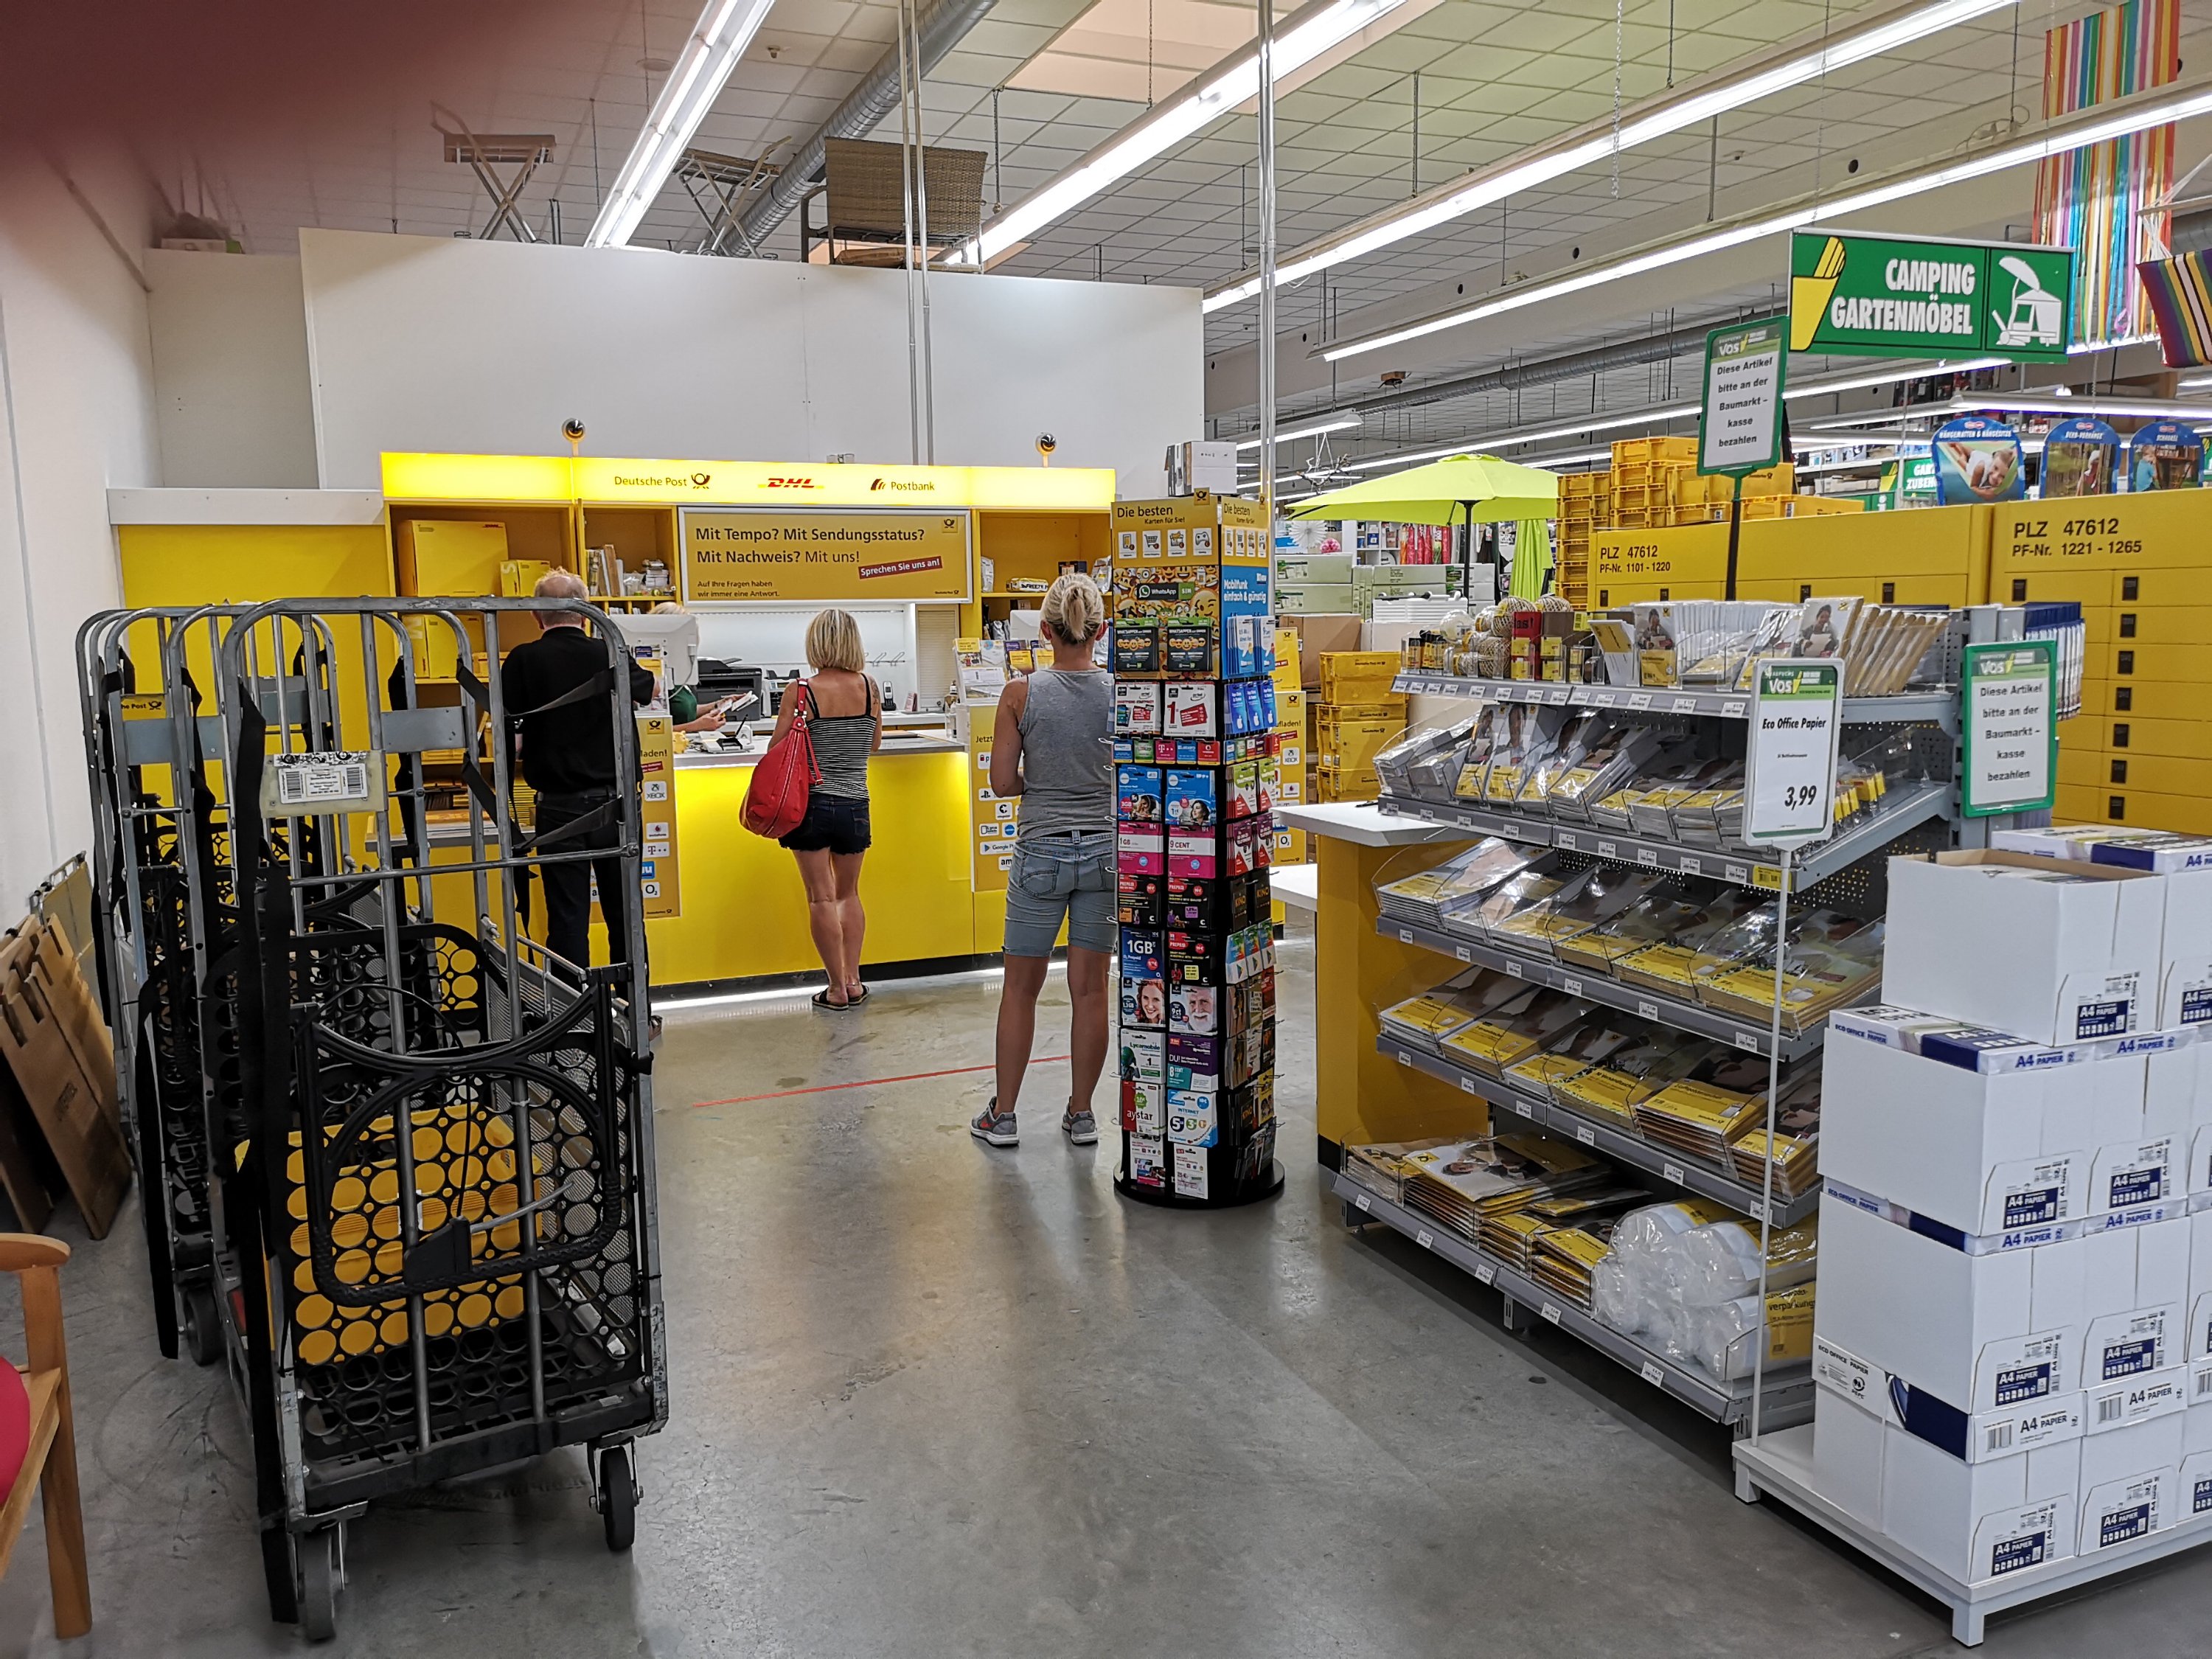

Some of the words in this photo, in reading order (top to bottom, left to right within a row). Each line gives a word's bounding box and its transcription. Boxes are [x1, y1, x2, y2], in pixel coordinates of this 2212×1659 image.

[1885, 258, 1975, 295] CAMPING
[1831, 293, 1973, 335] GARTENMÖBEL
[1719, 343, 1739, 356] VOS
[1717, 364, 1740, 375] Diese
[1742, 357, 1773, 370] Artikel
[1718, 383, 1738, 394] bitte
[1753, 377, 1768, 387] der
[1719, 397, 1761, 411] Baumarkt
[1728, 417, 1753, 428] kasse
[1719, 435, 1757, 447] bezahlen
[615, 476, 662, 486] Deutsche
[666, 477, 687, 487] Post
[768, 479, 815, 487] DHL
[891, 481, 935, 491] Postbank
[1117, 507, 1134, 518] Die
[1138, 506, 1173, 516] besten
[1224, 503, 1233, 514] Die
[1234, 504, 1251, 515] besten
[2014, 521, 2048, 538] PLZ
[2063, 518, 2119, 536] 47612
[696, 527, 720, 540] Mit
[724, 528, 779, 543] Tempo?
[784, 529, 807, 540] Mit
[812, 529, 925, 543] Sendungsstatus?
[1601, 547, 1619, 559] PLZ
[1627, 545, 1658, 558] 47612
[2012, 544, 2052, 557] PF-Nr.
[2061, 542, 2092, 555] 1221
[2108, 540, 2142, 553] 1265
[697, 551, 722, 563] Mit
[726, 550, 800, 563] Nachweis?
[805, 551, 828, 563] Mit
[832, 551, 860, 563] uns!
[860, 565, 897, 577] Sprechen
[898, 563, 910, 571] Sie
[912, 560, 925, 569] uns
[927, 558, 940, 567] an!
[1600, 563, 1621, 573] PF-Nr.
[1627, 563, 1644, 572] 1101
[1652, 562, 1671, 571] 1220
[1224, 579, 1248, 590] Mobilfunk
[1224, 591, 1242, 602] einfach
[1248, 591, 1266, 604] günstig
[1980, 661, 2005, 675] VOS
[1770, 679, 1793, 694] VOS
[1980, 687, 2008, 697] Diese
[2011, 684, 2042, 695] Artikel
[1167, 701, 1175, 724] 1
[1983, 709, 2006, 718] bitte
[2023, 706, 2039, 715] der
[1276, 720, 1301, 728] ufladen!
[1762, 718, 1774, 729] Eco
[1777, 717, 1799, 728] Office
[1801, 717, 1826, 731] Papier
[1986, 727, 2033, 739] Baumarkt
[640, 748, 667, 758] laden!
[1997, 750, 2025, 759] kasse
[1988, 770, 2031, 781] bezahlen
[1784, 785, 1817, 810] 3,99
[2185, 855, 2202, 868] A4
[1256, 887, 1269, 897] KINO
[1235, 895, 1247, 906] KINO
[1127, 940, 1154, 955] 1GB
[2185, 991, 2198, 1004] A4
[2079, 1006, 2096, 1018] A4
[2096, 1007, 2118, 1016] PAPIER
[1835, 1024, 1846, 1032] ECO
[1846, 1026, 1865, 1037] OFFICE
[1130, 1041, 1161, 1051] Lycamobile
[2117, 1040, 2135, 1054] A4
[2137, 1040, 2164, 1051] PAPIER
[2014, 1054, 2034, 1068] A4
[2037, 1055, 2063, 1065] PAPIER
[1127, 1110, 1153, 1121] aystar
[2112, 1175, 2129, 1187] A4
[2129, 1175, 2150, 1184] PAPIER
[1828, 1188, 1837, 1197] ECO
[1838, 1193, 1857, 1204] OFFICE
[2007, 1194, 2023, 1208] A4
[2025, 1194, 2046, 1205] PAPIER
[2105, 1214, 2124, 1228] A4
[2126, 1212, 2152, 1224] PAPIER
[2002, 1233, 2021, 1248] A4
[2024, 1234, 2051, 1244] PAPIER
[1818, 1345, 1829, 1354] ECO
[1829, 1351, 1847, 1363] OFFICE
[2106, 1347, 2121, 1360] A4
[2122, 1346, 2143, 1356] PAPIER
[1999, 1372, 2015, 1385] A4
[2016, 1370, 2038, 1380] PAPIER
[2129, 1390, 2145, 1405] A4
[2147, 1387, 2171, 1399] PAPIER
[2020, 1417, 2038, 1433] A4
[2040, 1415, 2067, 1427] PAPIER
[2196, 1481, 2210, 1493] A4
[2104, 1514, 2118, 1527] A4
[2118, 1512, 2138, 1523] PAPIER
[1995, 1543, 2010, 1556] A4
[2011, 1540, 2033, 1551] PAPIER
